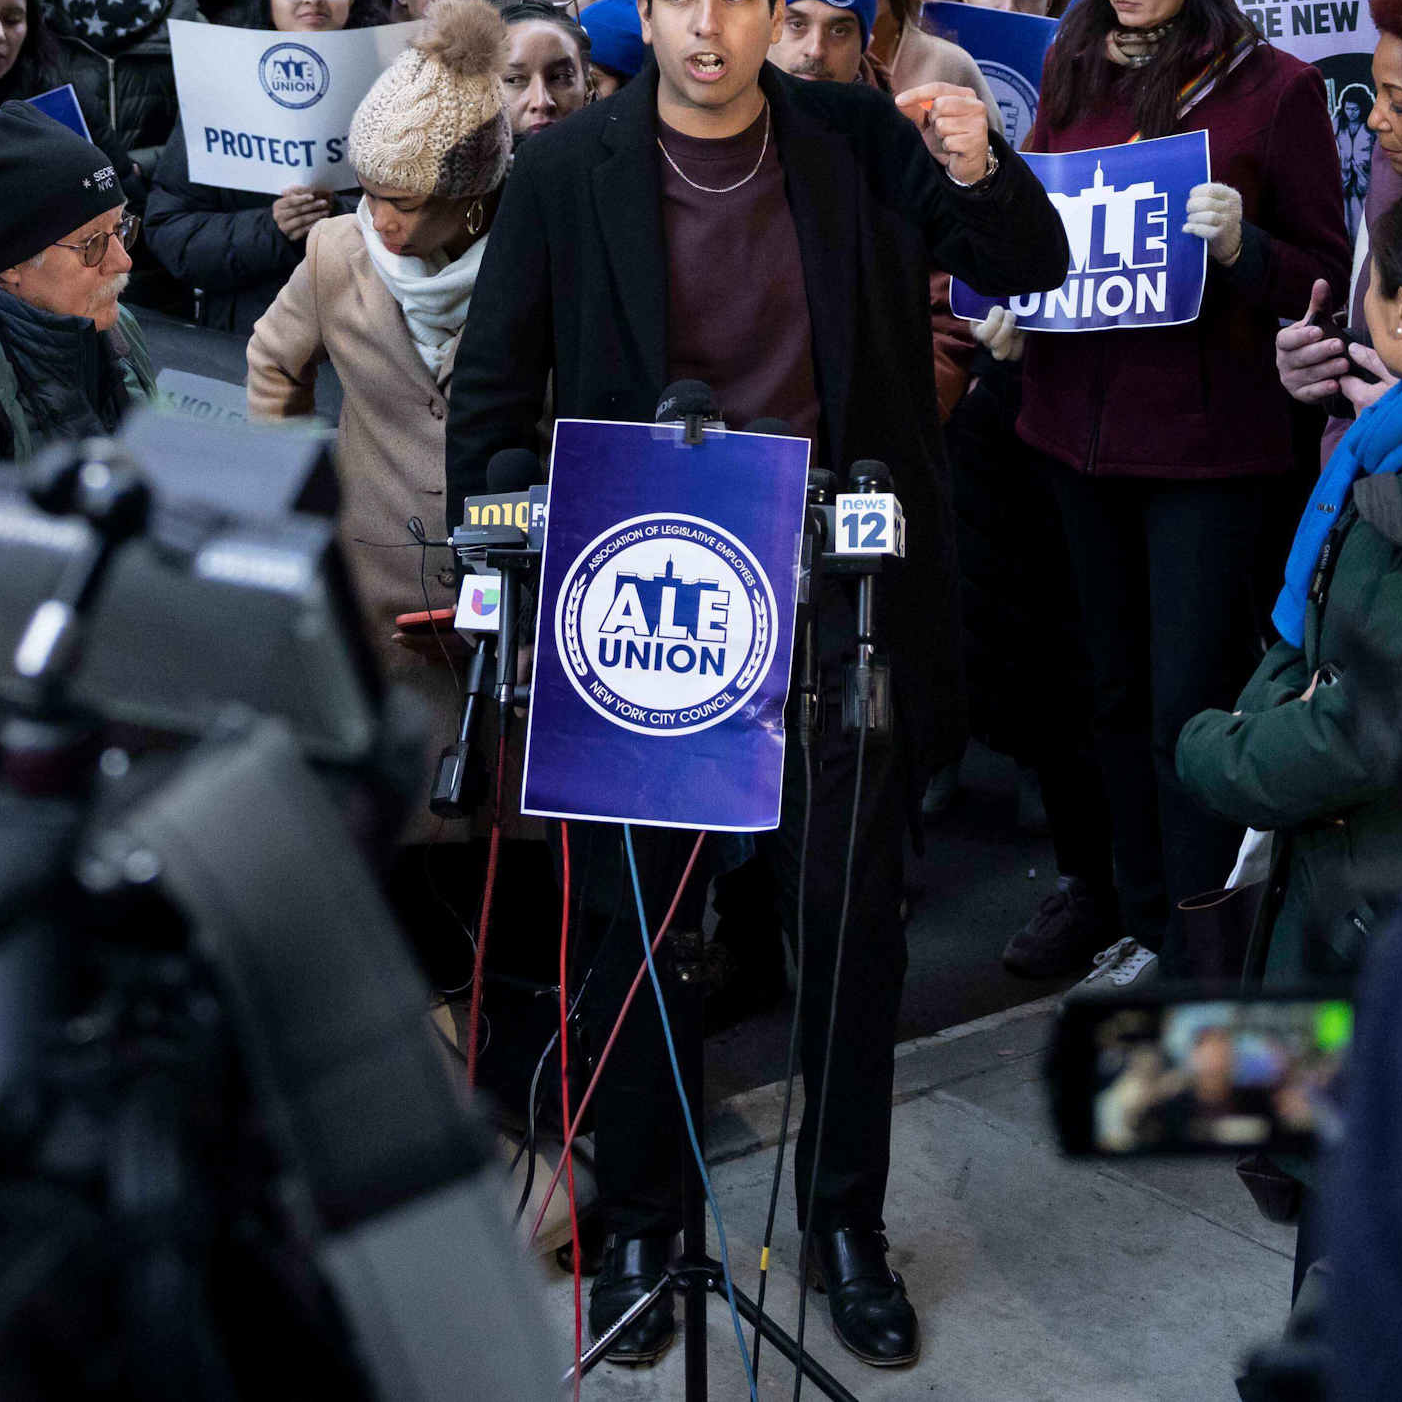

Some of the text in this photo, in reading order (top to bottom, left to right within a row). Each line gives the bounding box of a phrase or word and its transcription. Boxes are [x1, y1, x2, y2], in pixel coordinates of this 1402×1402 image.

[1291, 1, 1359, 36] NEW
[272, 60, 314, 80] ALE
[273, 81, 316, 93] UNION
[204, 127, 316, 167] PROTECT
[1009, 271, 1167, 319] UNION
[842, 498, 886, 510] news
[842, 512, 886, 548] 12
[588, 525, 757, 588] ASSOCIATION OF LEGISLATIVE EMPLOYEES
[599, 580, 731, 644] ALE
[599, 639, 725, 678] UNION
[589, 680, 734, 725] NEW YORK CITY COUNCIL
